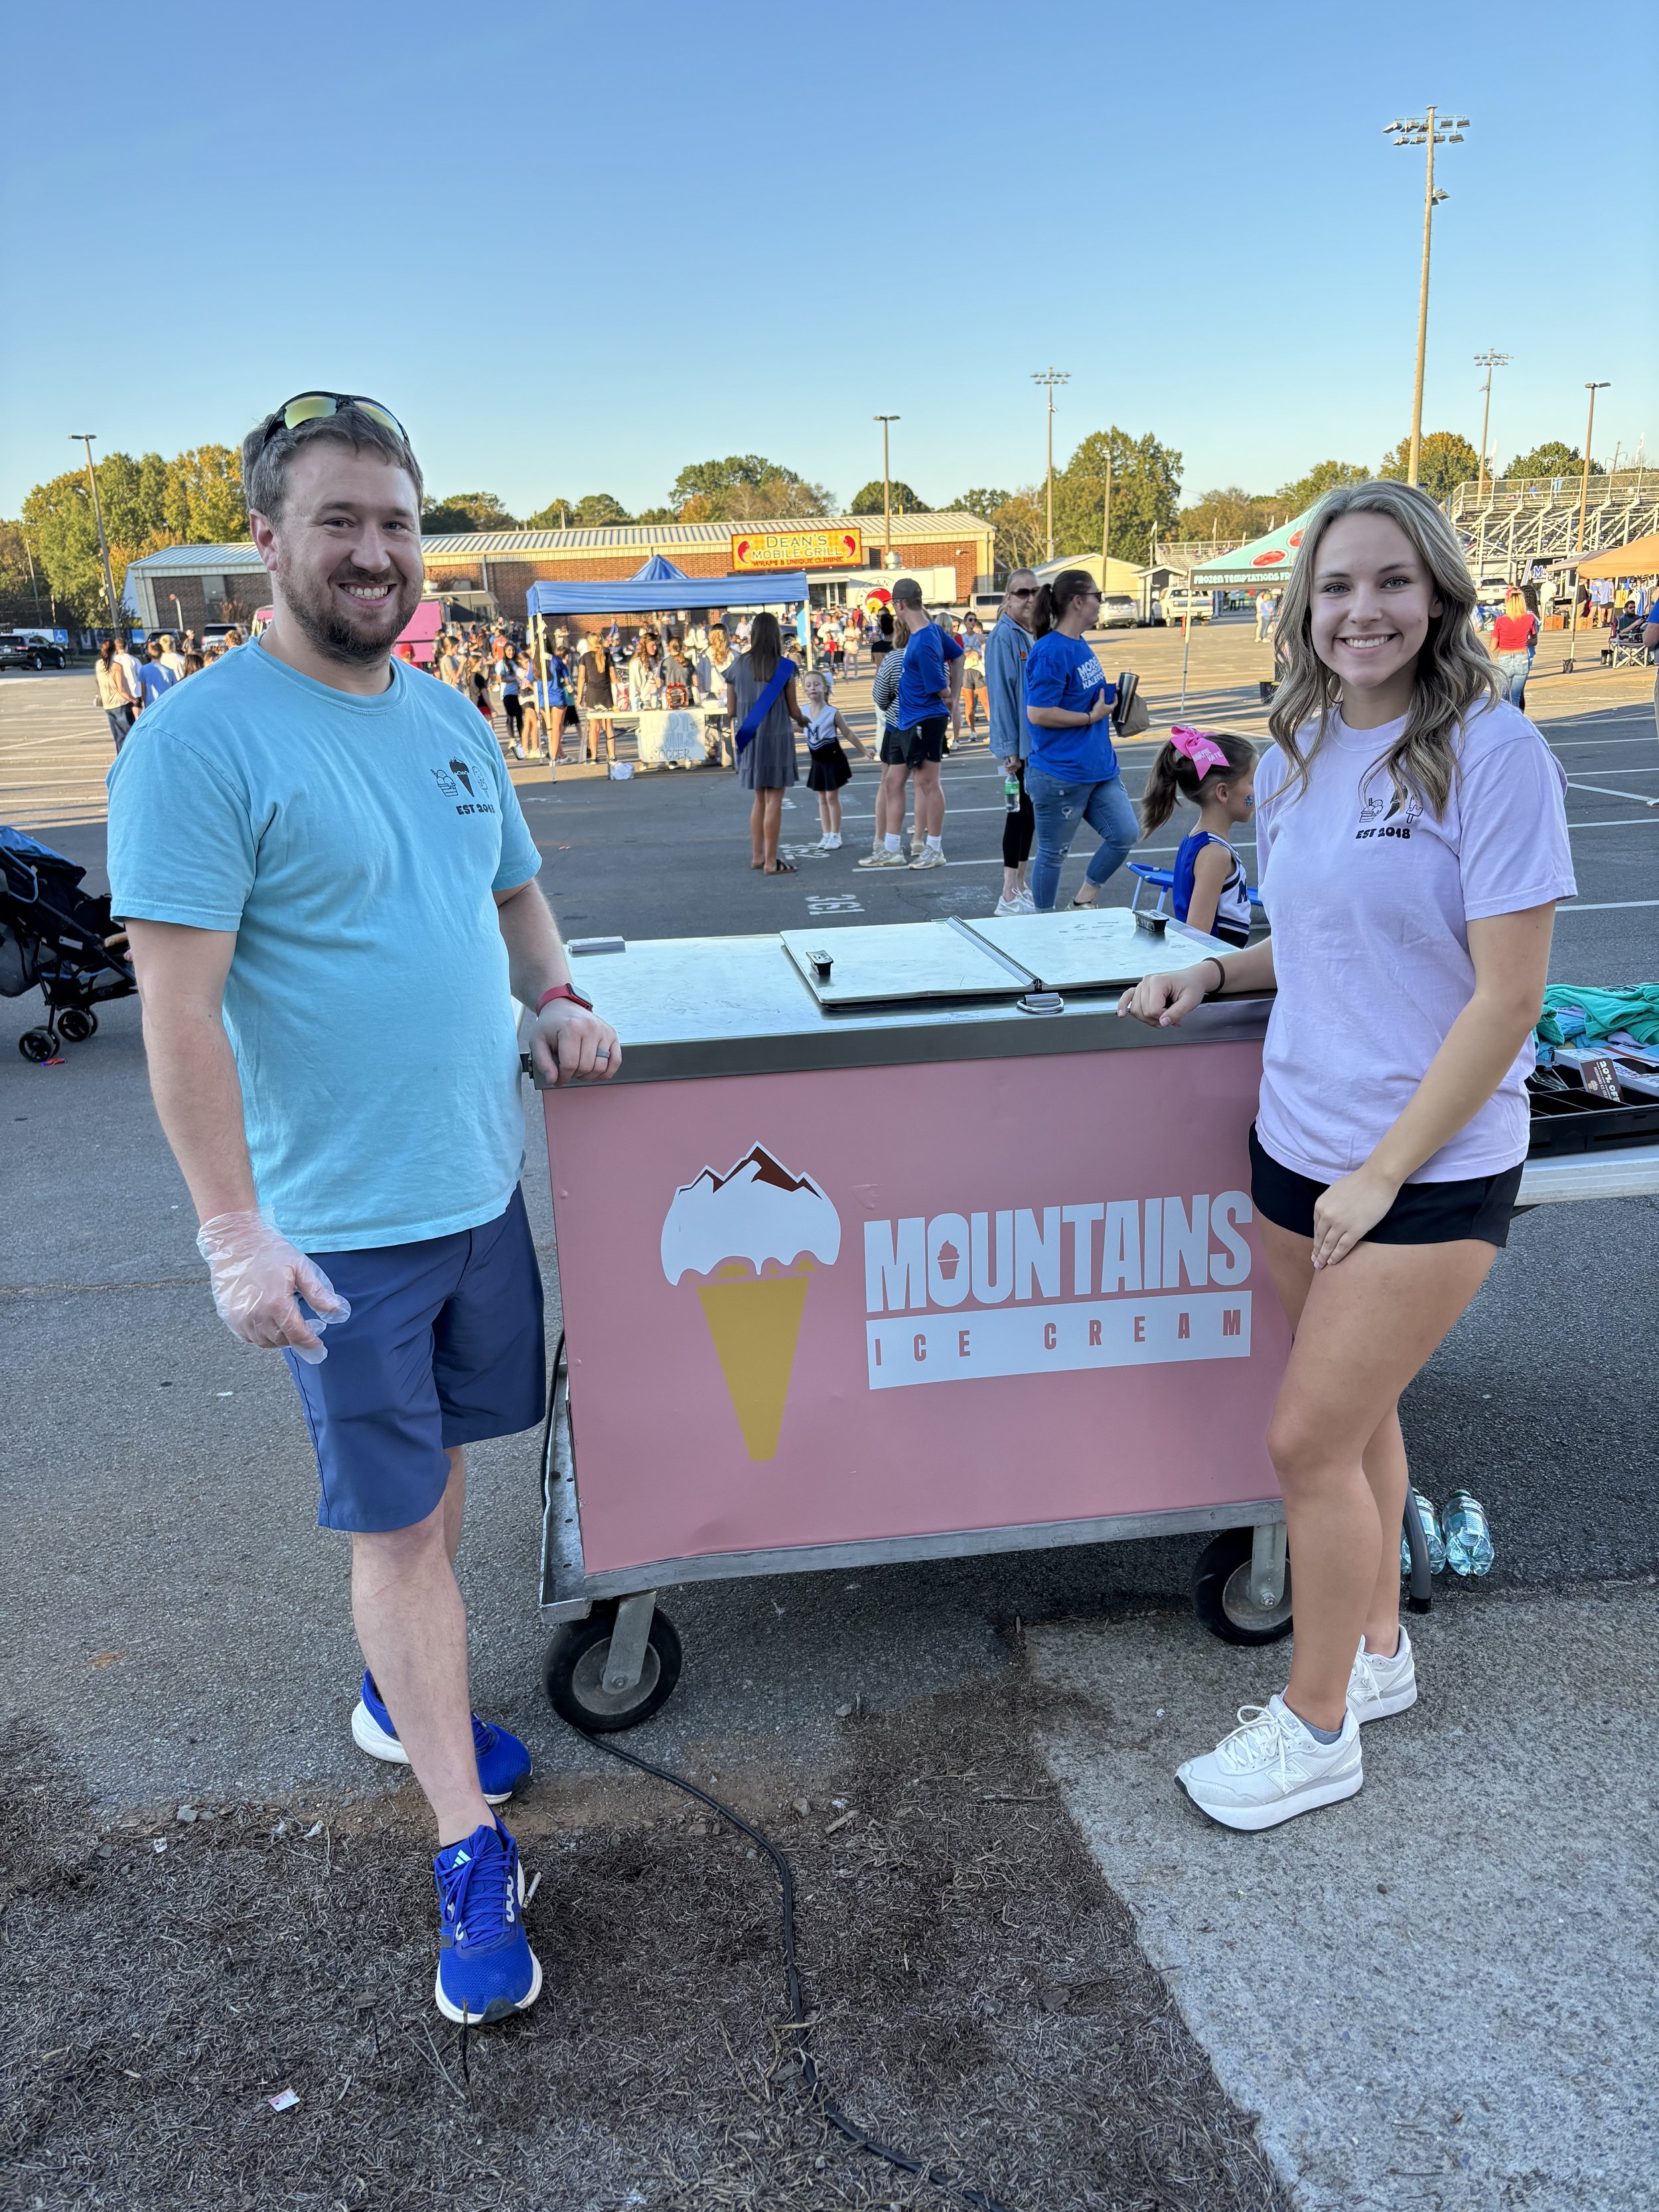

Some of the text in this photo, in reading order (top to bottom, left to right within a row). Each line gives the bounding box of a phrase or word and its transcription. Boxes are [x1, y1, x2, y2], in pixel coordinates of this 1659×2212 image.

[766, 534, 828, 548] DEAN'S
[751, 546, 843, 559] MOBILE GRILL
[650, 748, 691, 760] SOCCER
[456, 804, 475, 815] EST
[1356, 827, 1410, 839] EST 2018
[1599, 1061, 1613, 1083] 20%
[864, 1190, 1253, 1313] MOUNTAINS
[875, 1309, 1241, 1366] ICE CREAM
